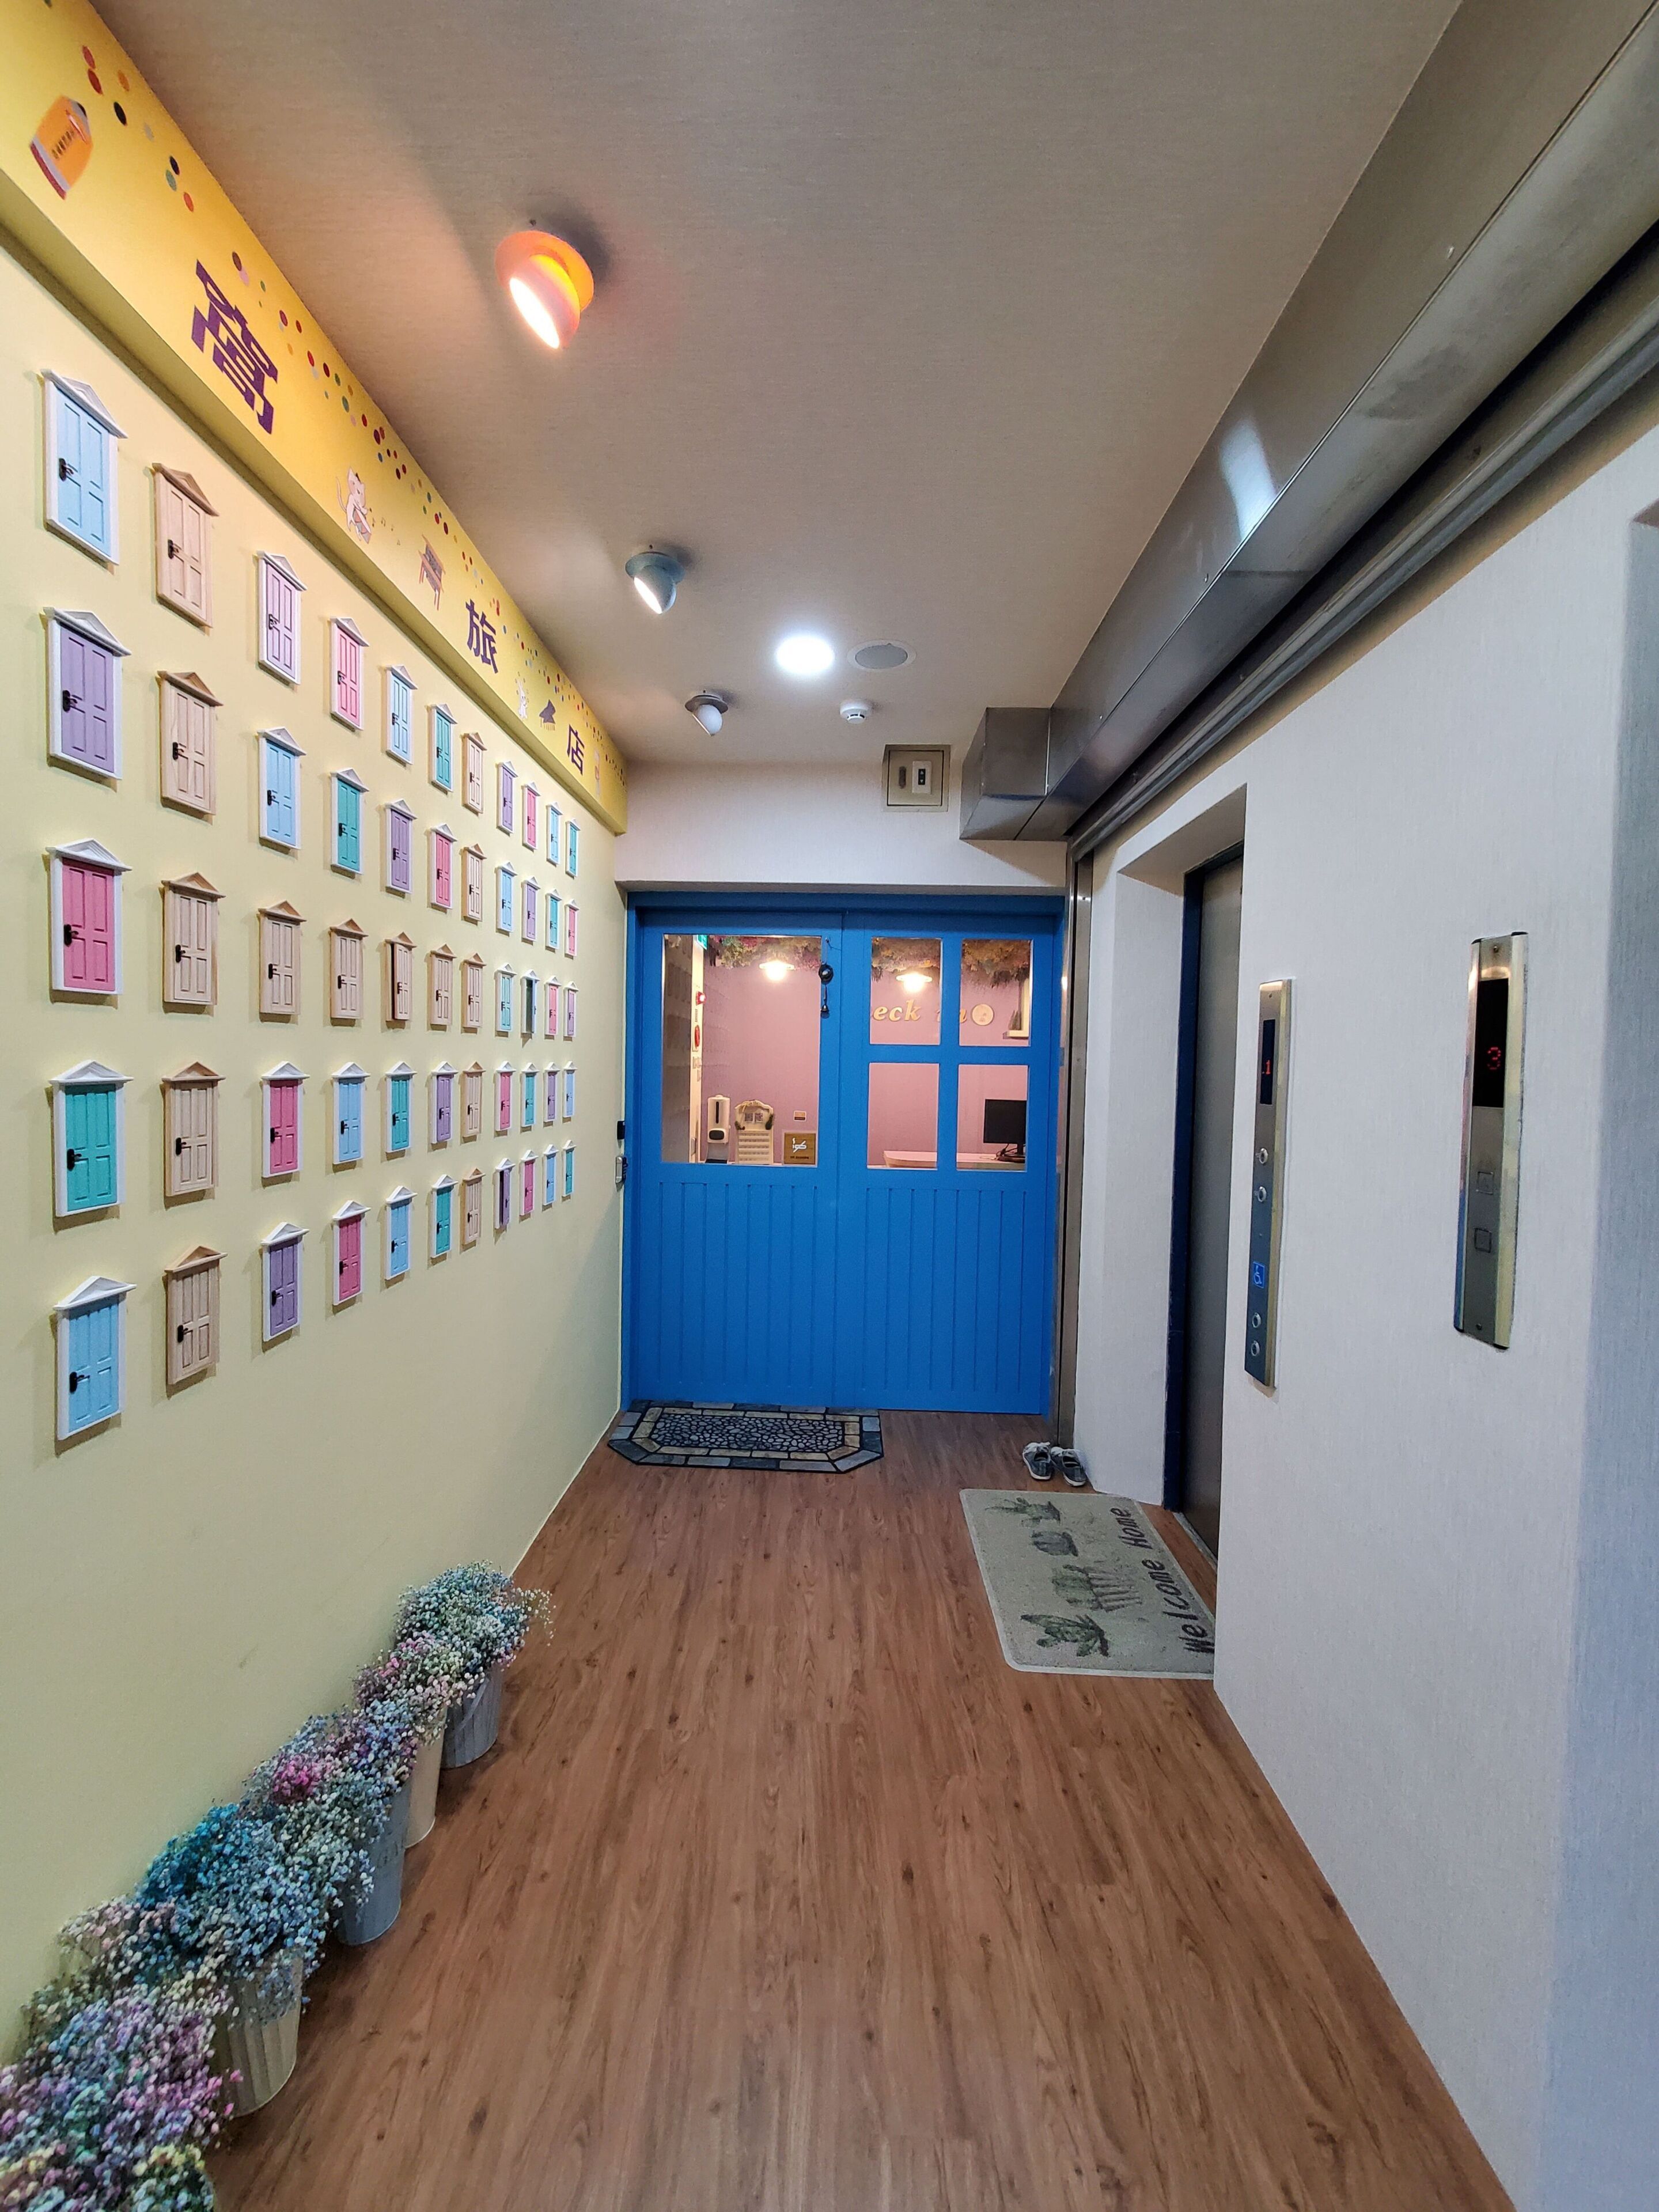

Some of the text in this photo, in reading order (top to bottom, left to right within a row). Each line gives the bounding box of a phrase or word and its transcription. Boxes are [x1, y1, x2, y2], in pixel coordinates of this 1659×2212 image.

[191, 259, 585, 776] 窩 旅 店
[873, 999, 921, 1021] eck
[1487, 1047, 1501, 1070] 3
[1110, 1507, 1215, 1654] Welcome Home
